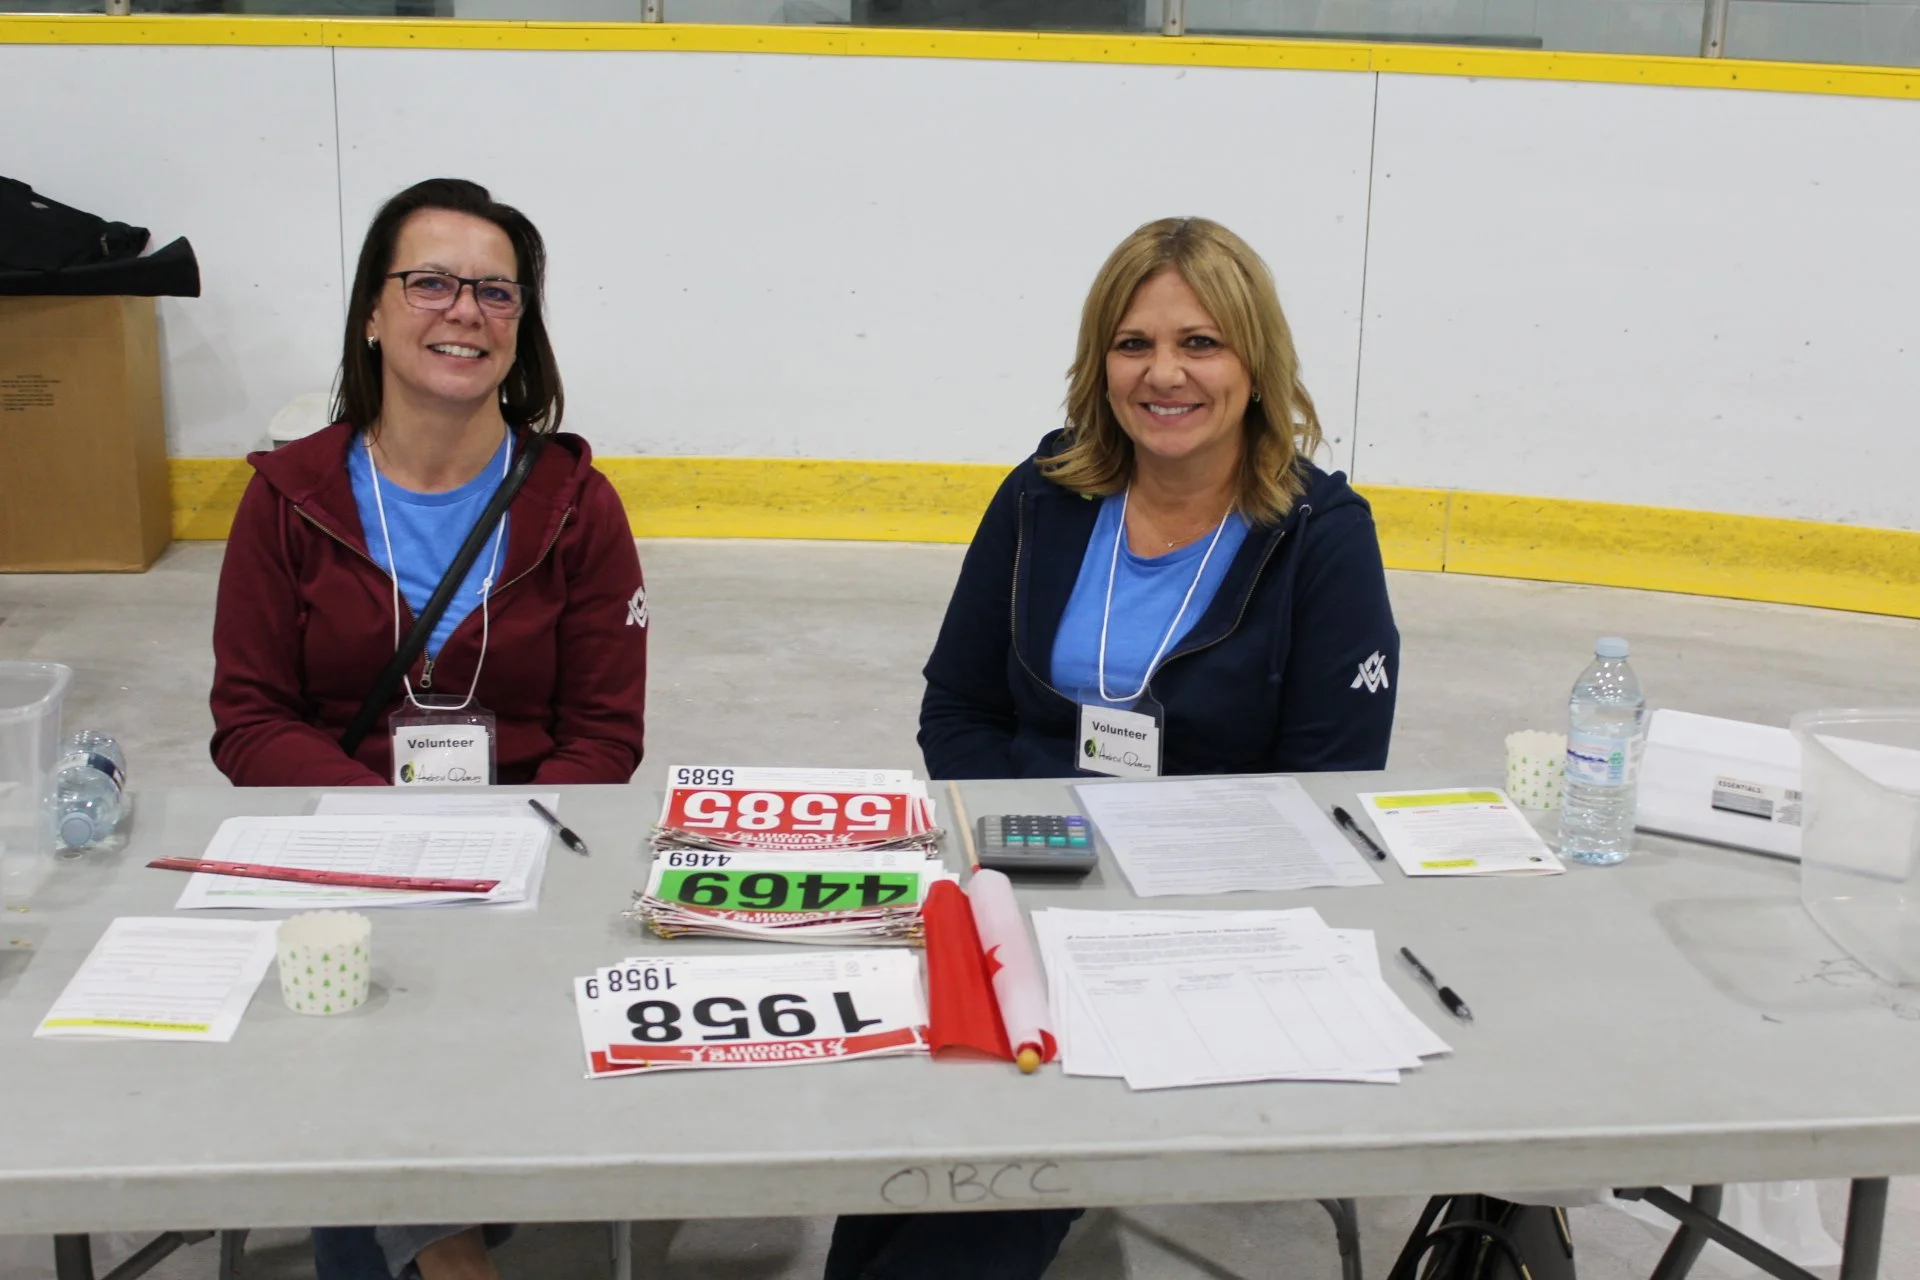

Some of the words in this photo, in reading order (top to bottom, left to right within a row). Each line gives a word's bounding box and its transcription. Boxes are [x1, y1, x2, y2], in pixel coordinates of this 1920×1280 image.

[1092, 721, 1148, 741] Volunteer
[407, 738, 474, 749] Volunteer
[678, 768, 735, 786] 5585
[683, 791, 892, 831] 5585
[669, 852, 732, 867] 4469
[678, 872, 909, 910] 4469
[608, 967, 677, 993] 1958
[626, 991, 883, 1042] 1958
